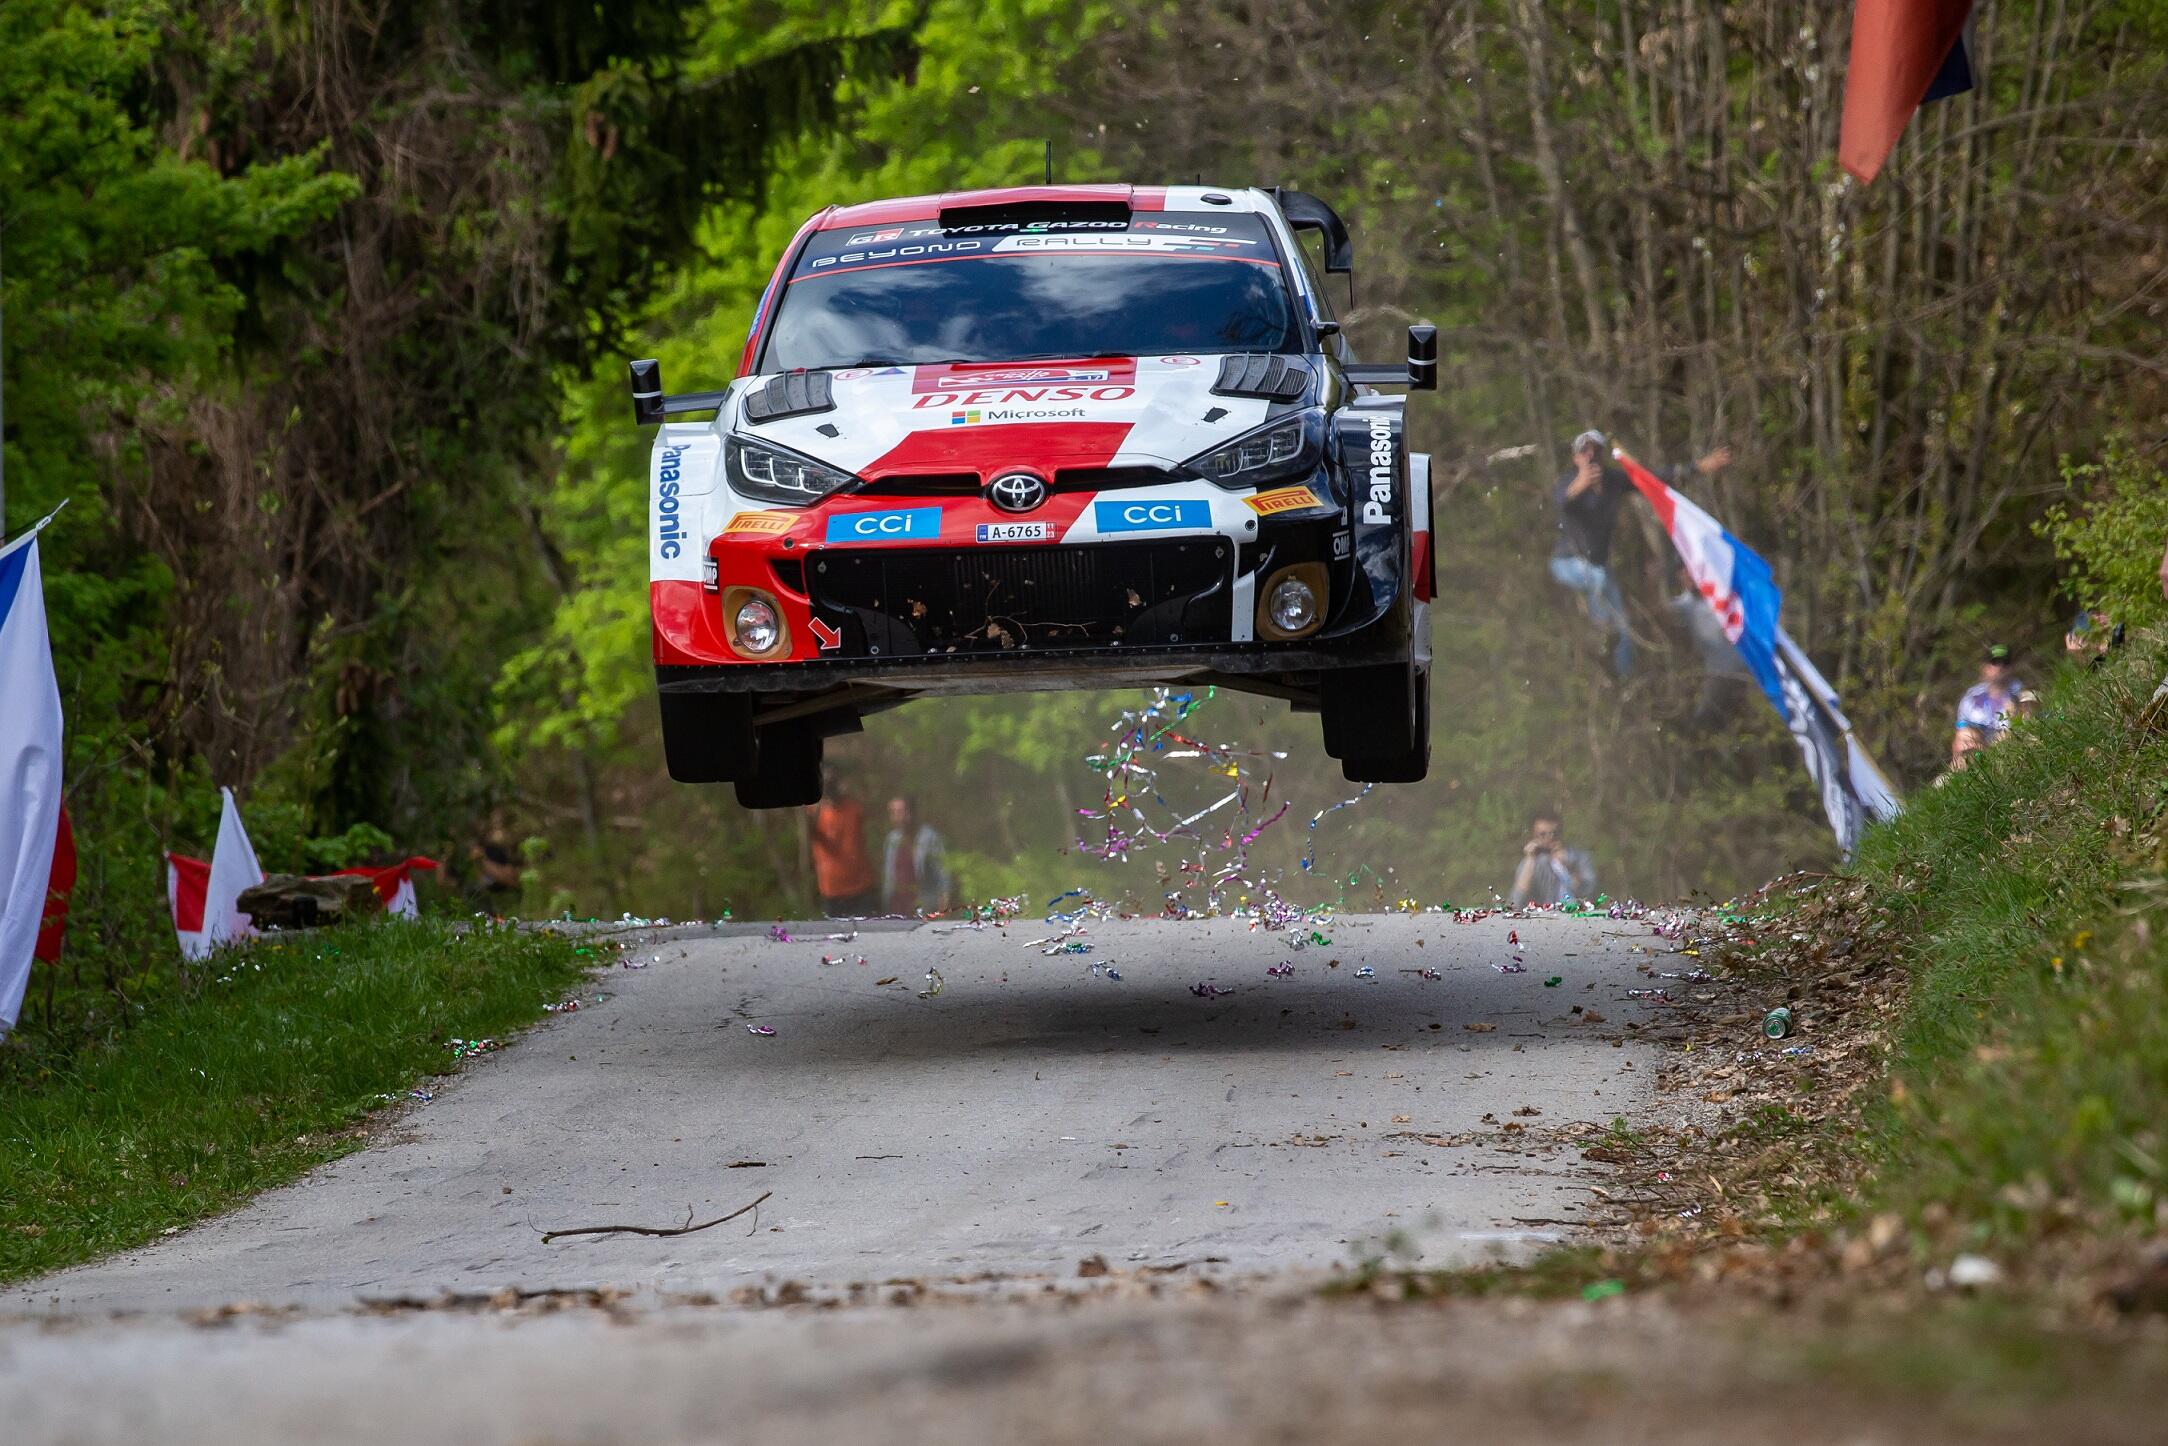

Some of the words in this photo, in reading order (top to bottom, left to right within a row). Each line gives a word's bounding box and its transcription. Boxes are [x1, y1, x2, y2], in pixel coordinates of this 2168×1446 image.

[850, 231, 898, 245] GR
[909, 224, 1019, 236] TOYOTA
[1020, 221, 1128, 232] GAZOO
[1134, 221, 1227, 233] Racing
[812, 241, 981, 268] BEYOND
[1017, 238, 1151, 246] RALLY
[912, 387, 1136, 409] DENSO
[988, 408, 1086, 420] Microsoft
[1251, 490, 1317, 511] PIRELLI
[729, 514, 791, 530] PIRELLI
[992, 526, 1041, 539] A-6765
